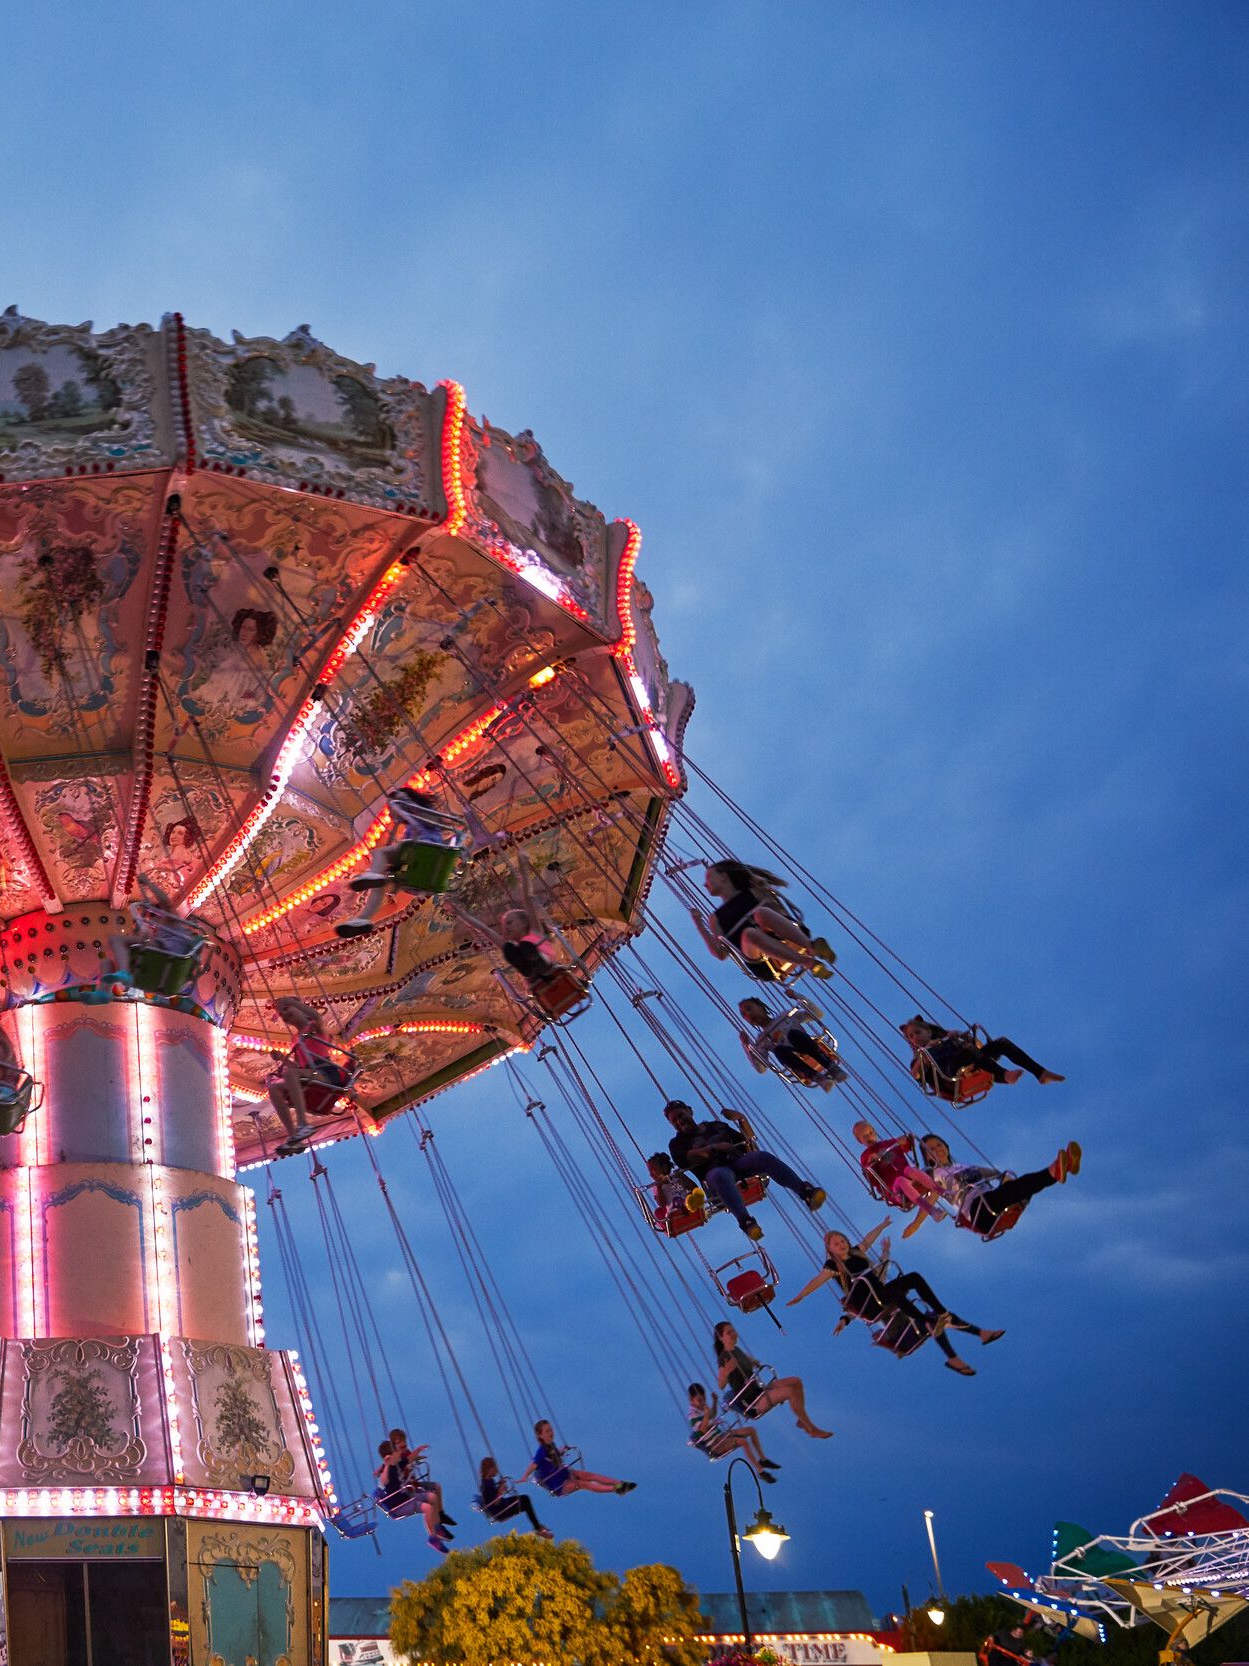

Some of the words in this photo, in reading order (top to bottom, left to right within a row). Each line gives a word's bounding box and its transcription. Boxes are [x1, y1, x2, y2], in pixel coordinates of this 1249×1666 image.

[14, 1530, 49, 1548] New
[53, 1520, 155, 1538] Double
[66, 1539, 140, 1555] Seats
[781, 1642, 848, 1664] TIME
